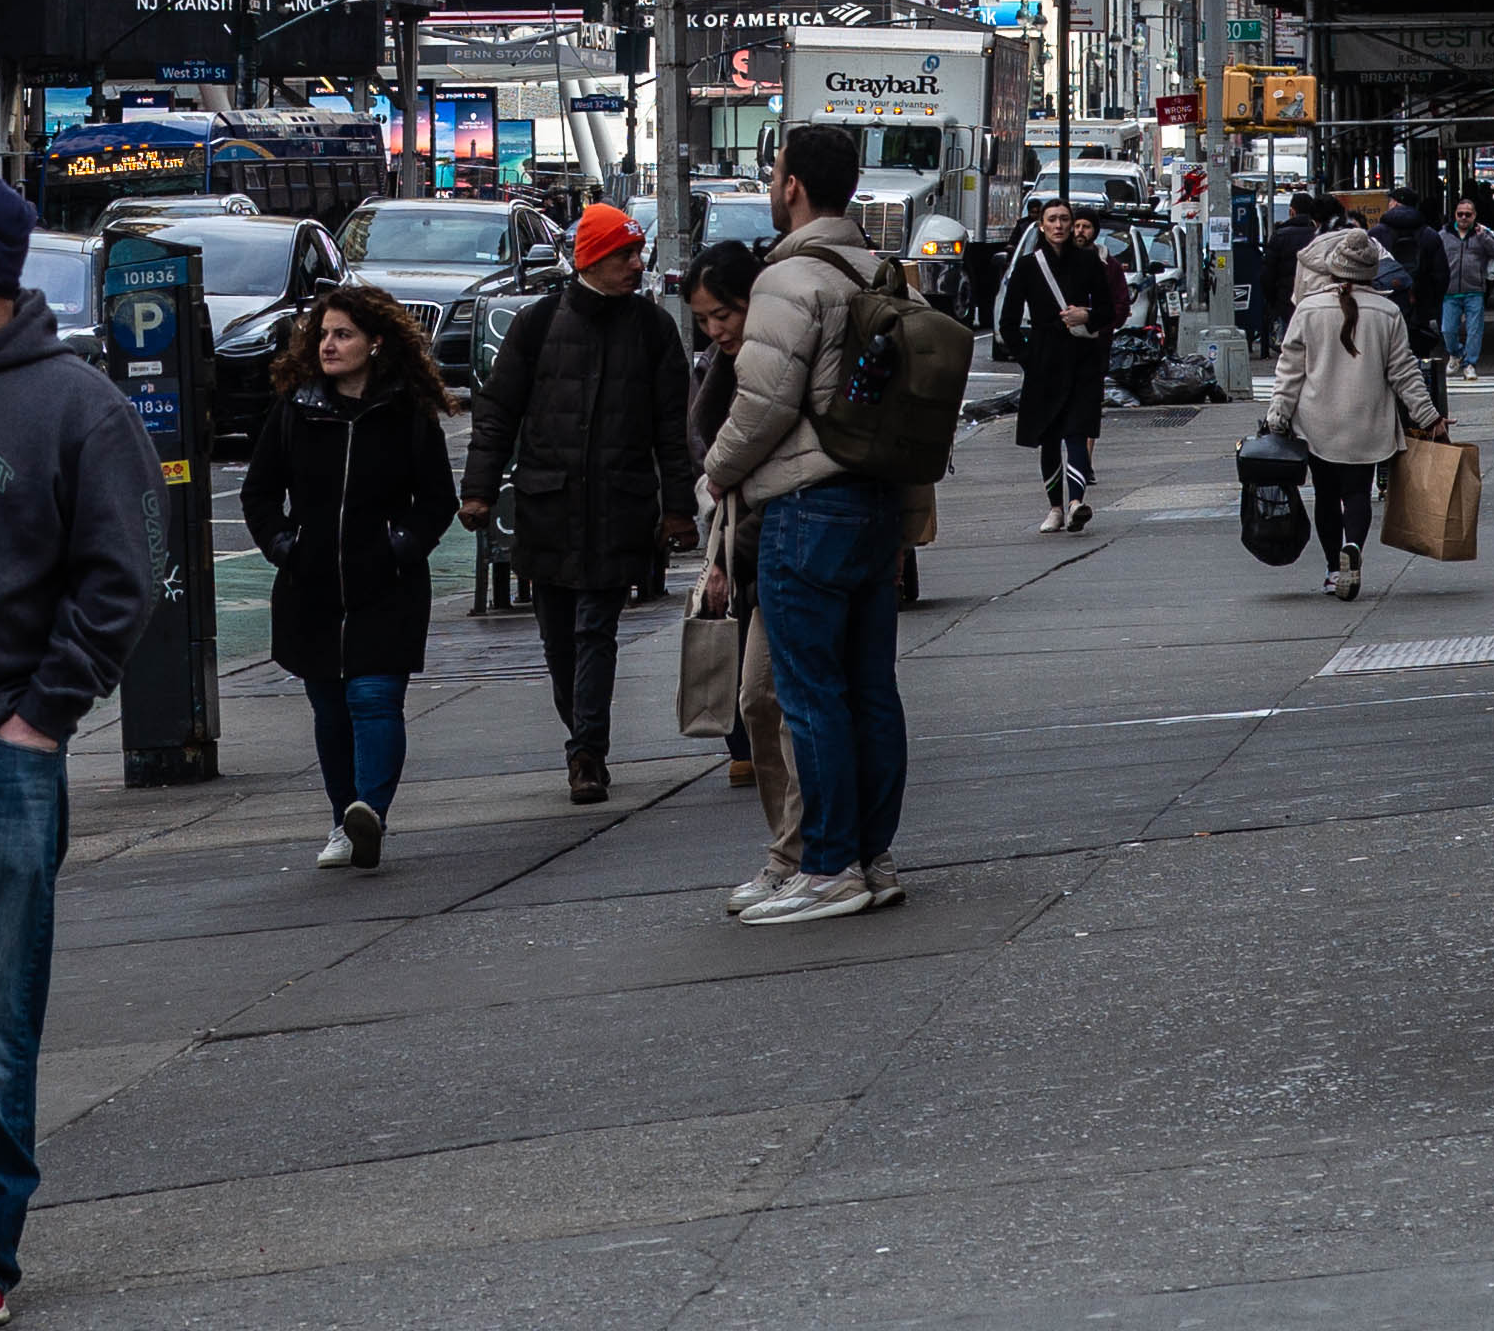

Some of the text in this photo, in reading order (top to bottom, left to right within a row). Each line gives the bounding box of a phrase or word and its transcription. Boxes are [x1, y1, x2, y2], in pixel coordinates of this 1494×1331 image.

[704, 15, 728, 28] OF
[733, 12, 825, 28] AMERICA
[1249, 22, 1257, 31] ST
[454, 49, 552, 59] PENN STATION
[162, 67, 226, 79] West 31st St
[827, 98, 939, 110] works to your advantage
[1164, 105, 1193, 116] WRONG
[1171, 113, 1187, 123] WAY
[124, 270, 175, 286] 101836
[134, 302, 163, 348] P
